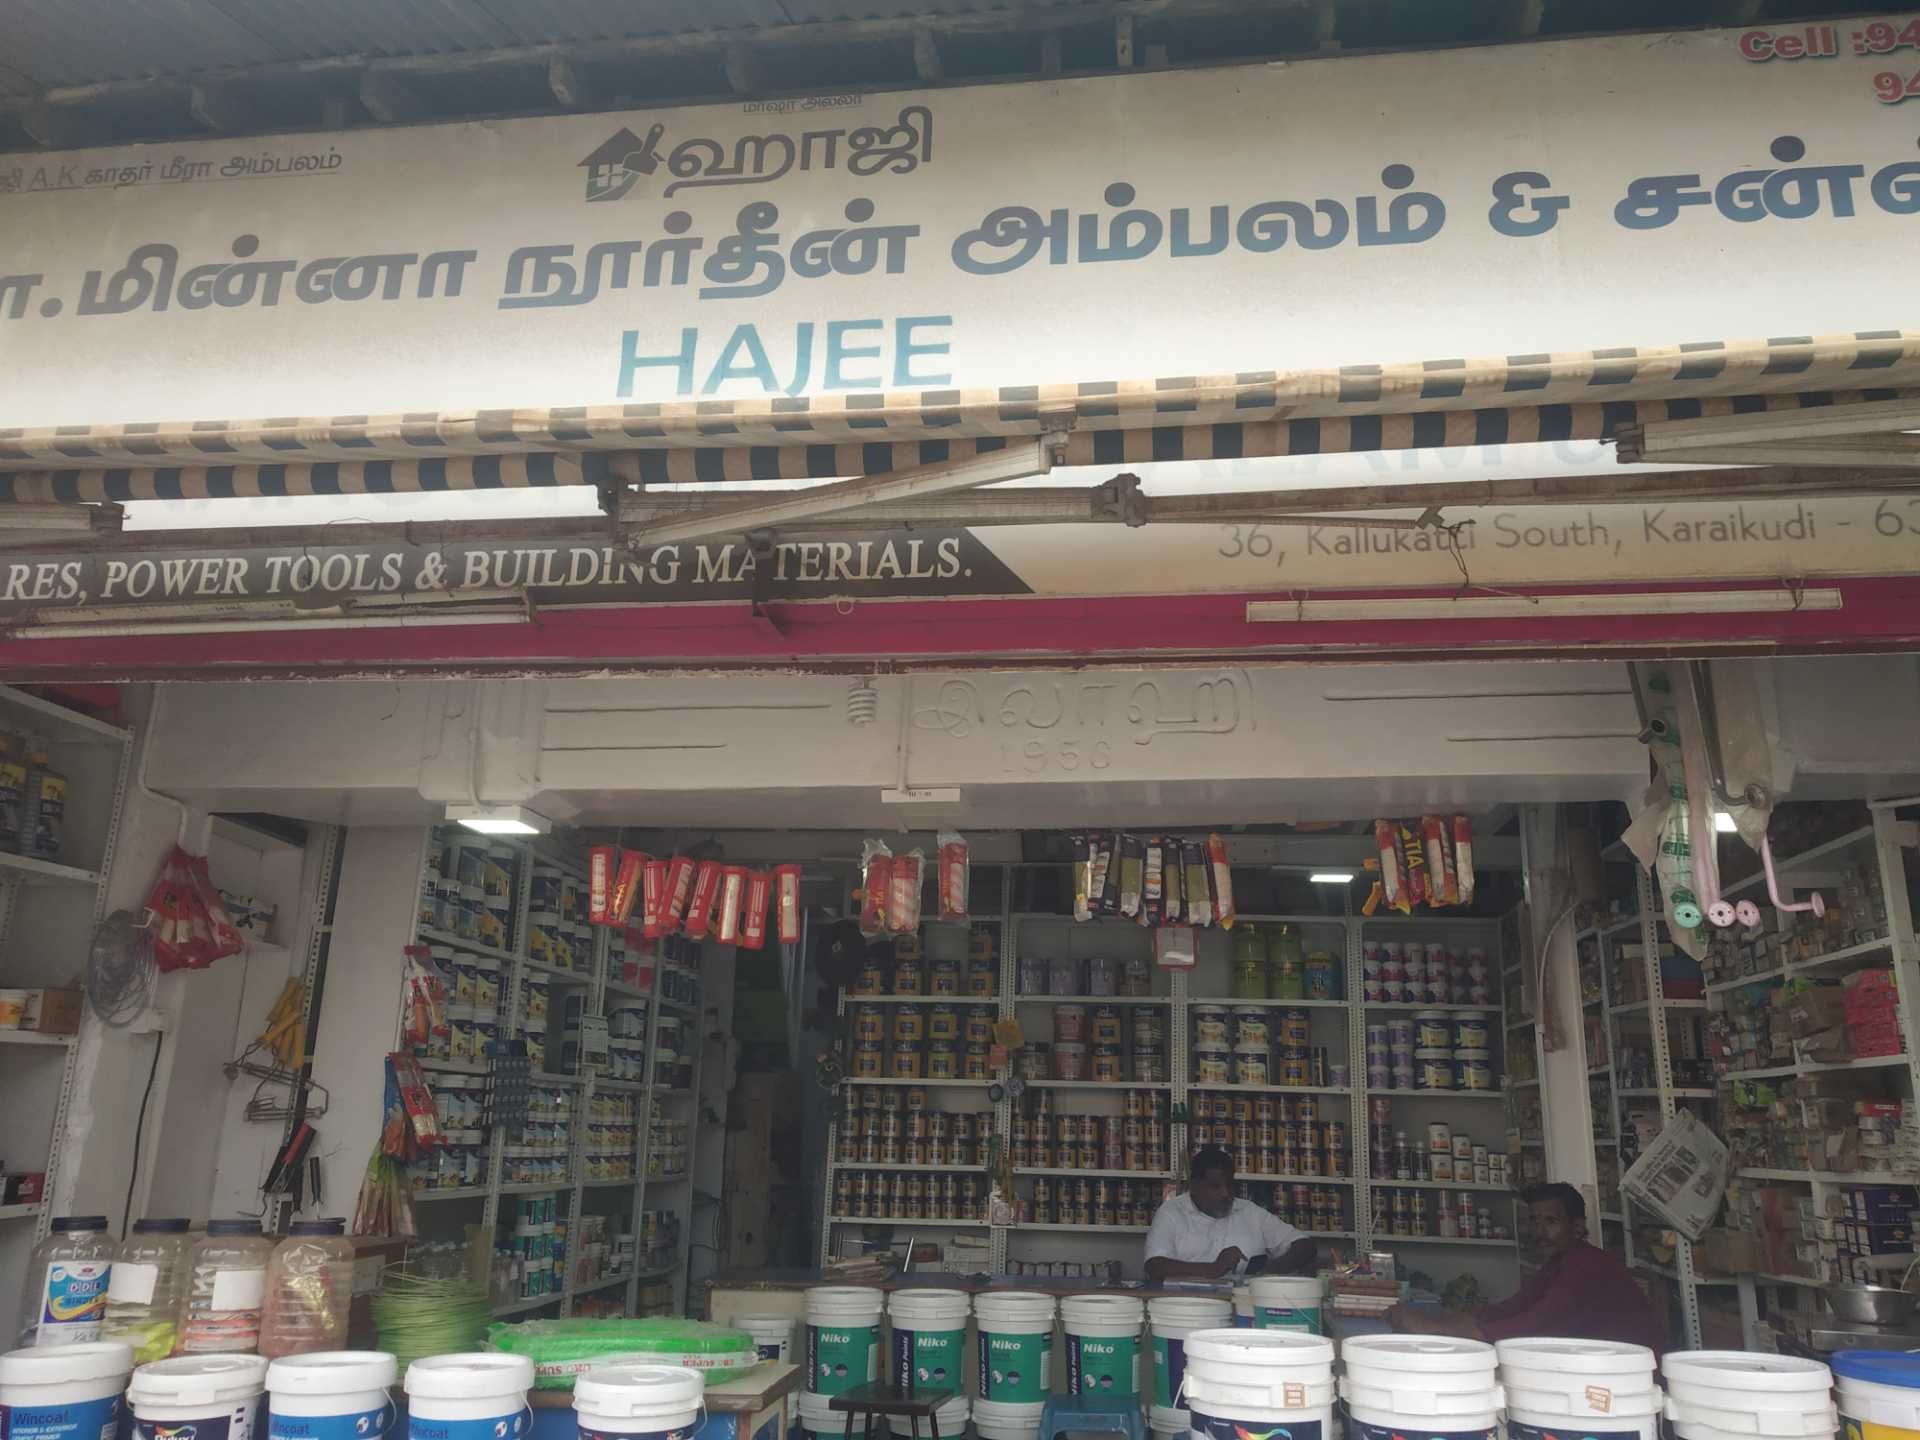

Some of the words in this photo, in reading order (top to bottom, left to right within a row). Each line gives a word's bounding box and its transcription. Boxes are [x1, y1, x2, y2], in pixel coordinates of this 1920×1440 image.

[1740, 26, 1837, 61] Cell
[84, 160, 155, 190] காதர்
[160, 154, 214, 182] மீரா
[219, 146, 343, 178] அம்பலம்
[663, 105, 933, 199] ஹாஜி
[950, 162, 1447, 276] அம்பலம்
[1488, 171, 1570, 237] &
[615, 314, 953, 398] HAJEE
[1217, 523, 1287, 568] 36,
[1494, 512, 1622, 556] South,
[1641, 500, 1817, 544] Karaikudi
[5, 562, 87, 604] RES,
[100, 555, 249, 600] POWER
[264, 552, 403, 594] TOOLS
[414, 551, 448, 591] &
[821, 1333, 851, 1344] Niko
[917, 1337, 948, 1348] Niko
[990, 1339, 1022, 1351] Niko
[1083, 1343, 1115, 1354] Niko
[15, 1410, 70, 1425] Wincoat
